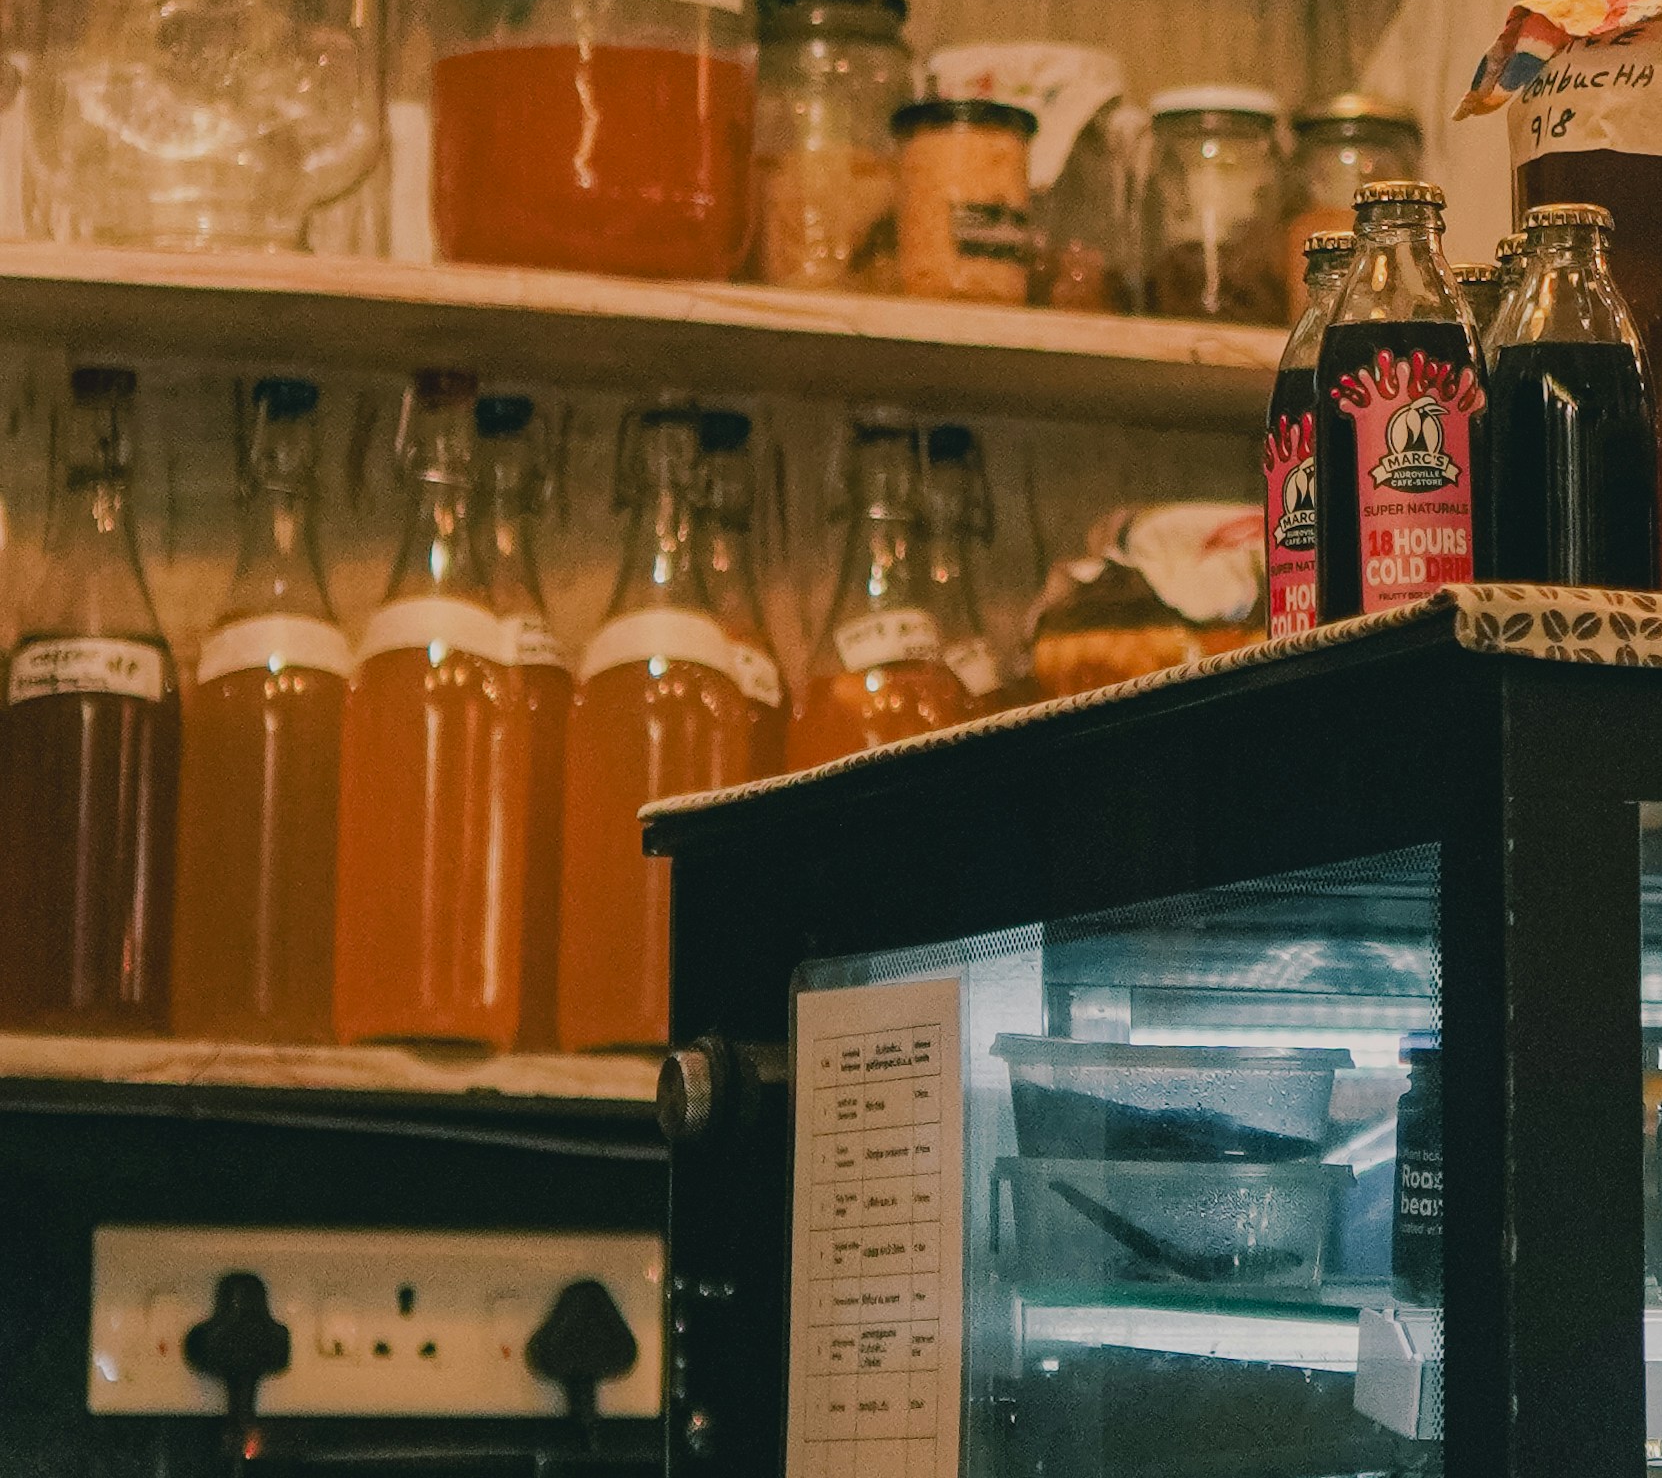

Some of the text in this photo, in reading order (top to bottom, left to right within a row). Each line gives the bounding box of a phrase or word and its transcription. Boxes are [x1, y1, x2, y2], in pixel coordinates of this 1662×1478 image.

[1531, 106, 1575, 147] 9/8
[1387, 453, 1445, 469] MARC'S
[1393, 470, 1440, 479] AUROVILLE
[1364, 502, 1469, 516] SUPER NATURALS
